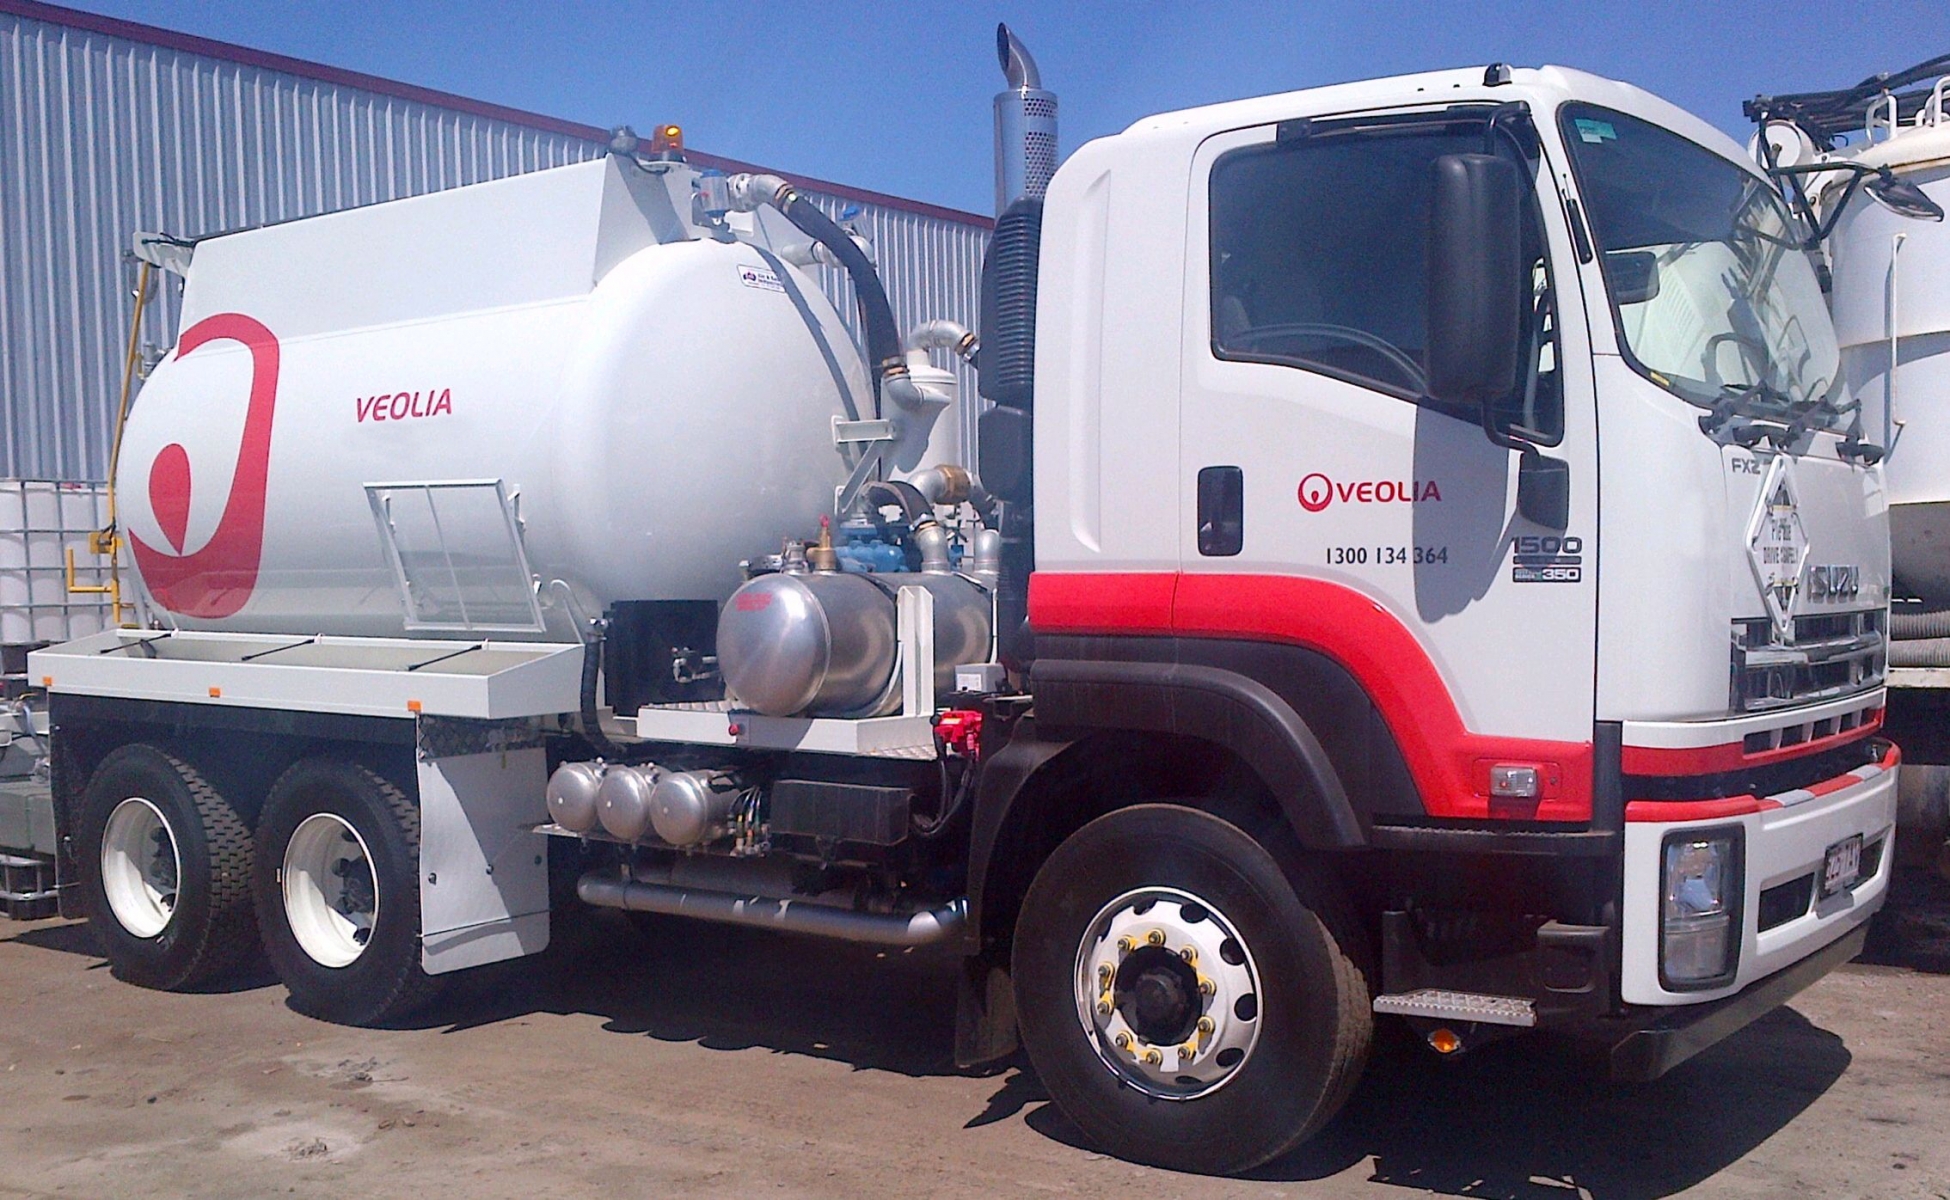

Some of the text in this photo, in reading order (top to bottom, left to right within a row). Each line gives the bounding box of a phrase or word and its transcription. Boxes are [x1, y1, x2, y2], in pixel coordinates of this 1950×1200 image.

[357, 388, 452, 422] VEOLIA
[1336, 481, 1442, 503] VEOLIA
[1511, 536, 1582, 554] 1500
[1326, 547, 1448, 564] 1300 134 364
[1542, 569, 1579, 580] 350
